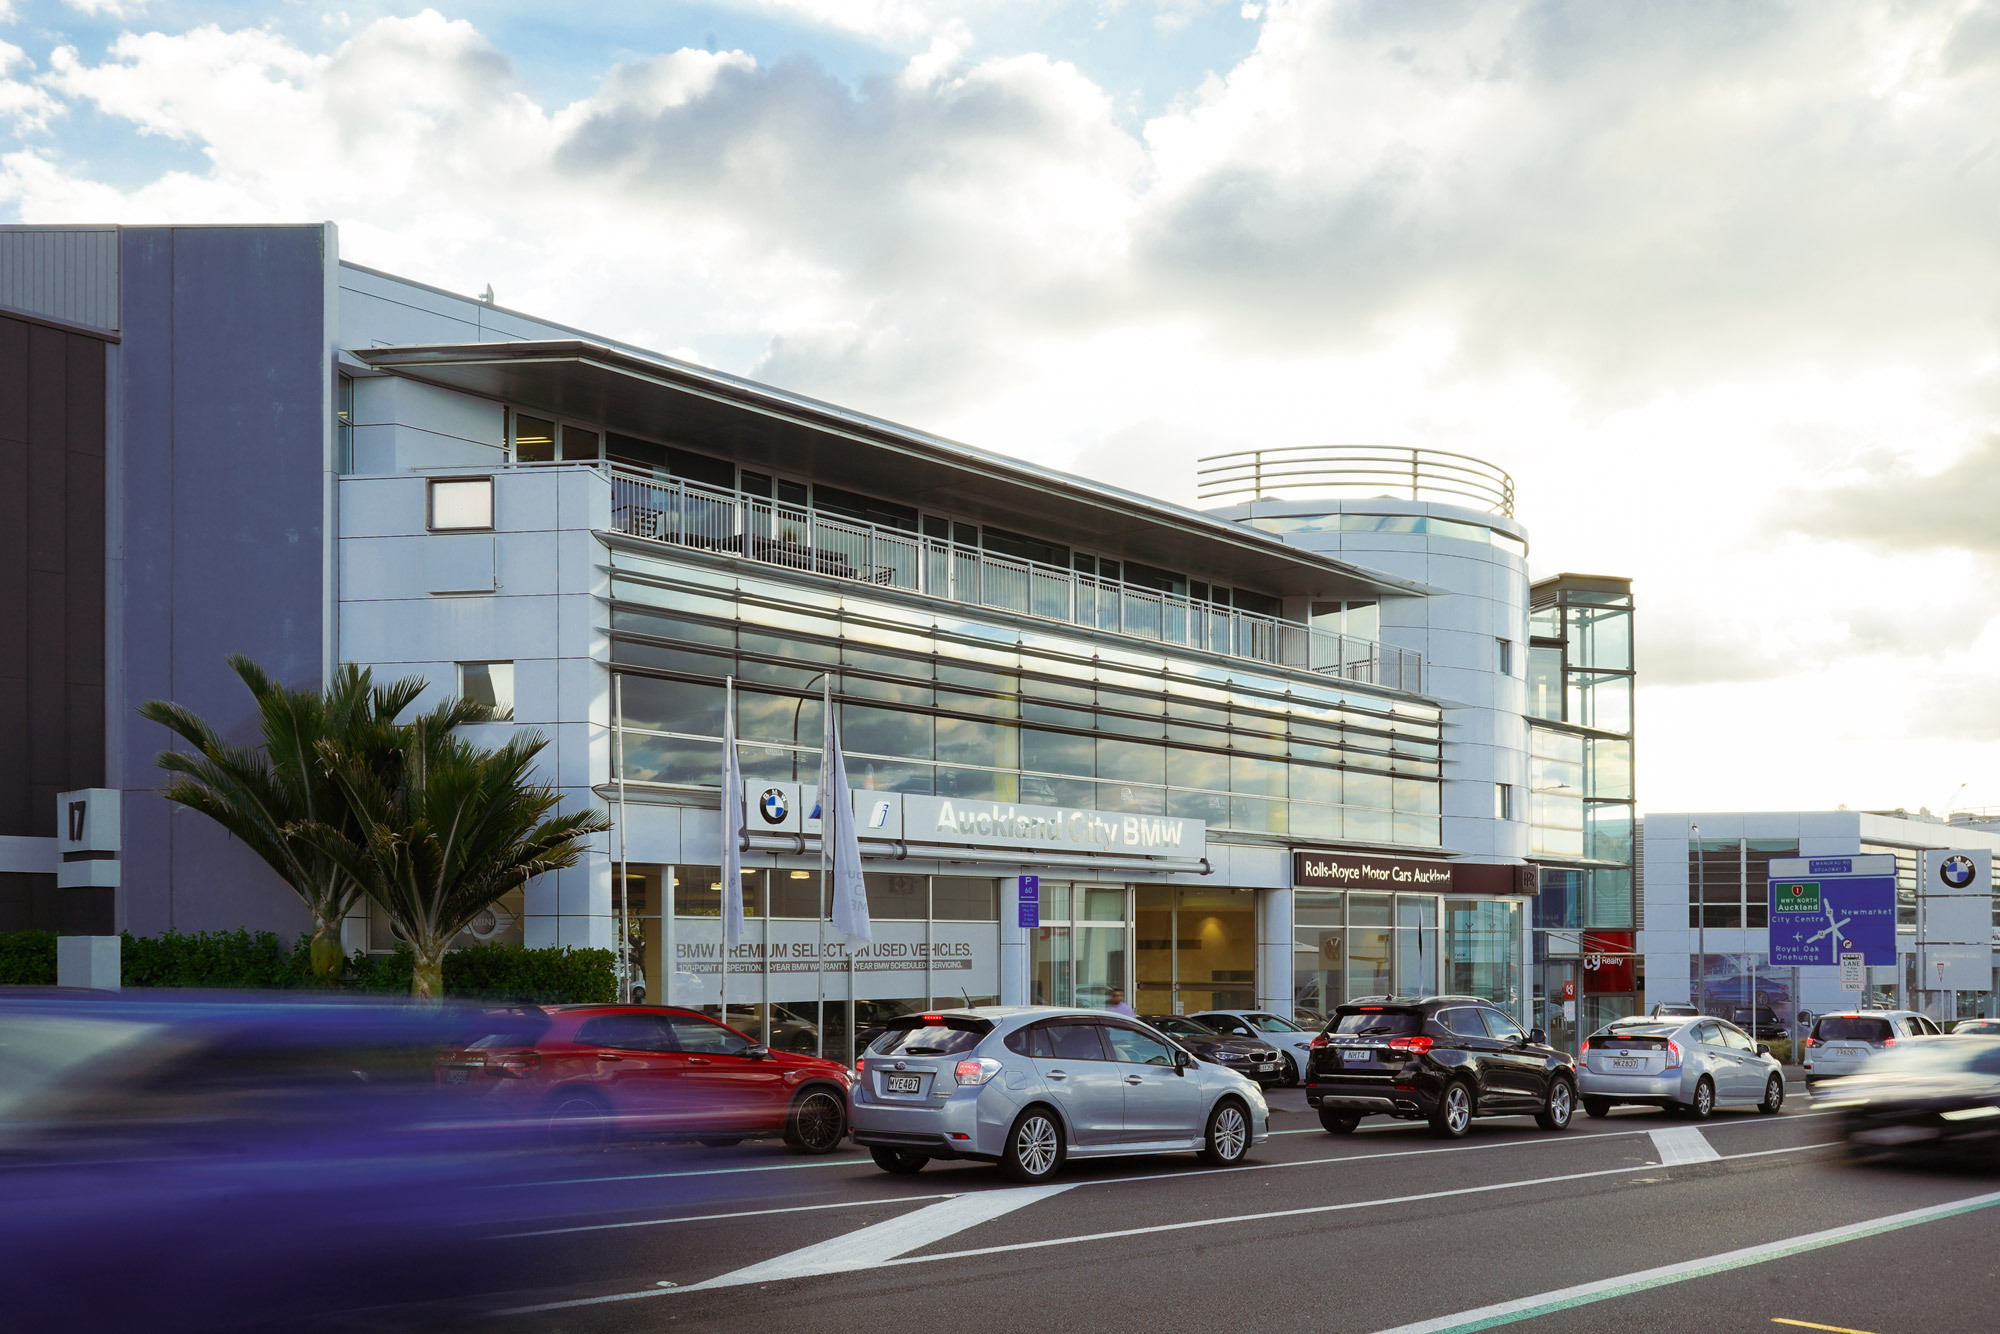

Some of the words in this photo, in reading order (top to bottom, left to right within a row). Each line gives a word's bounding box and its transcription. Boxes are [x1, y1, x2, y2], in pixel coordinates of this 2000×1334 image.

[69, 800, 86, 841] 17
[936, 801, 1062, 841] Auckland
[1067, 811, 1117, 851] City
[1123, 816, 1183, 849] BMW
[1305, 861, 1360, 883] Rolls-Royce
[1362, 865, 1390, 881] Motor
[1392, 866, 1412, 882] Cars
[1413, 868, 1451, 884] Auckland
[1025, 877, 1033, 885] P
[473, 918, 495, 926] MINI
[1771, 916, 1793, 924] City
[676, 943, 715, 958] BMW
[792, 943, 870, 958] SELECTN
[873, 943, 907, 957] USED
[910, 943, 972, 957] VEHICLES.
[1775, 945, 1799, 953] Royal
[1602, 957, 1624, 967] Realty
[1776, 954, 1819, 962] Onehunga
[679, 964, 717, 972] 100-POINT
[719, 963, 762, 972] ISPECTION.
[792, 962, 809, 971] BMW
[810, 962, 848, 971] WARANTY.
[874, 962, 889, 970] BMW
[890, 962, 926, 970] SCHEDULED
[931, 961, 962, 969] SERVICING.
